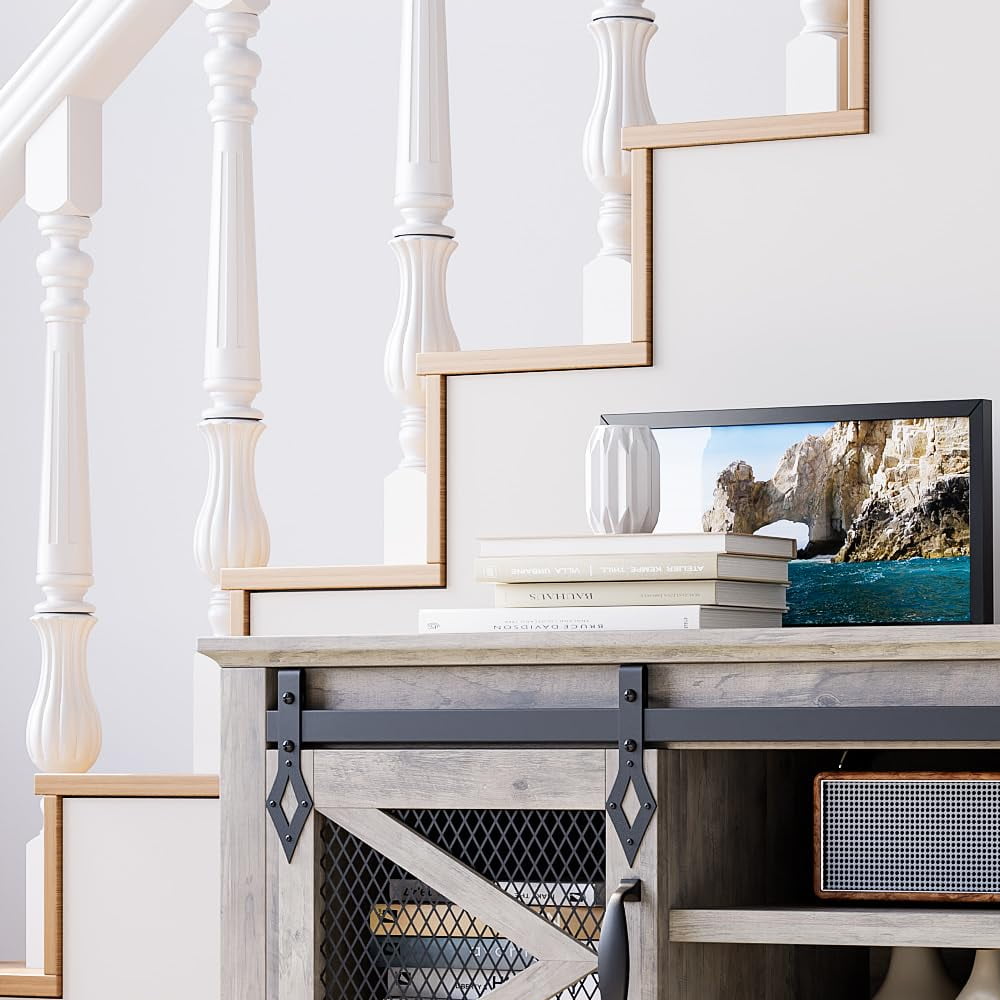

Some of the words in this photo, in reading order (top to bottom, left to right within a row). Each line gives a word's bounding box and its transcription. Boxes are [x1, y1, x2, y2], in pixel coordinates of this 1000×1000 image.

[554, 567, 581, 575] VILLA
[600, 566, 624, 575] THILL
[631, 566, 662, 574] KEMPE
[667, 565, 705, 573] ATELIER
[529, 592, 593, 600] BAUHAUS
